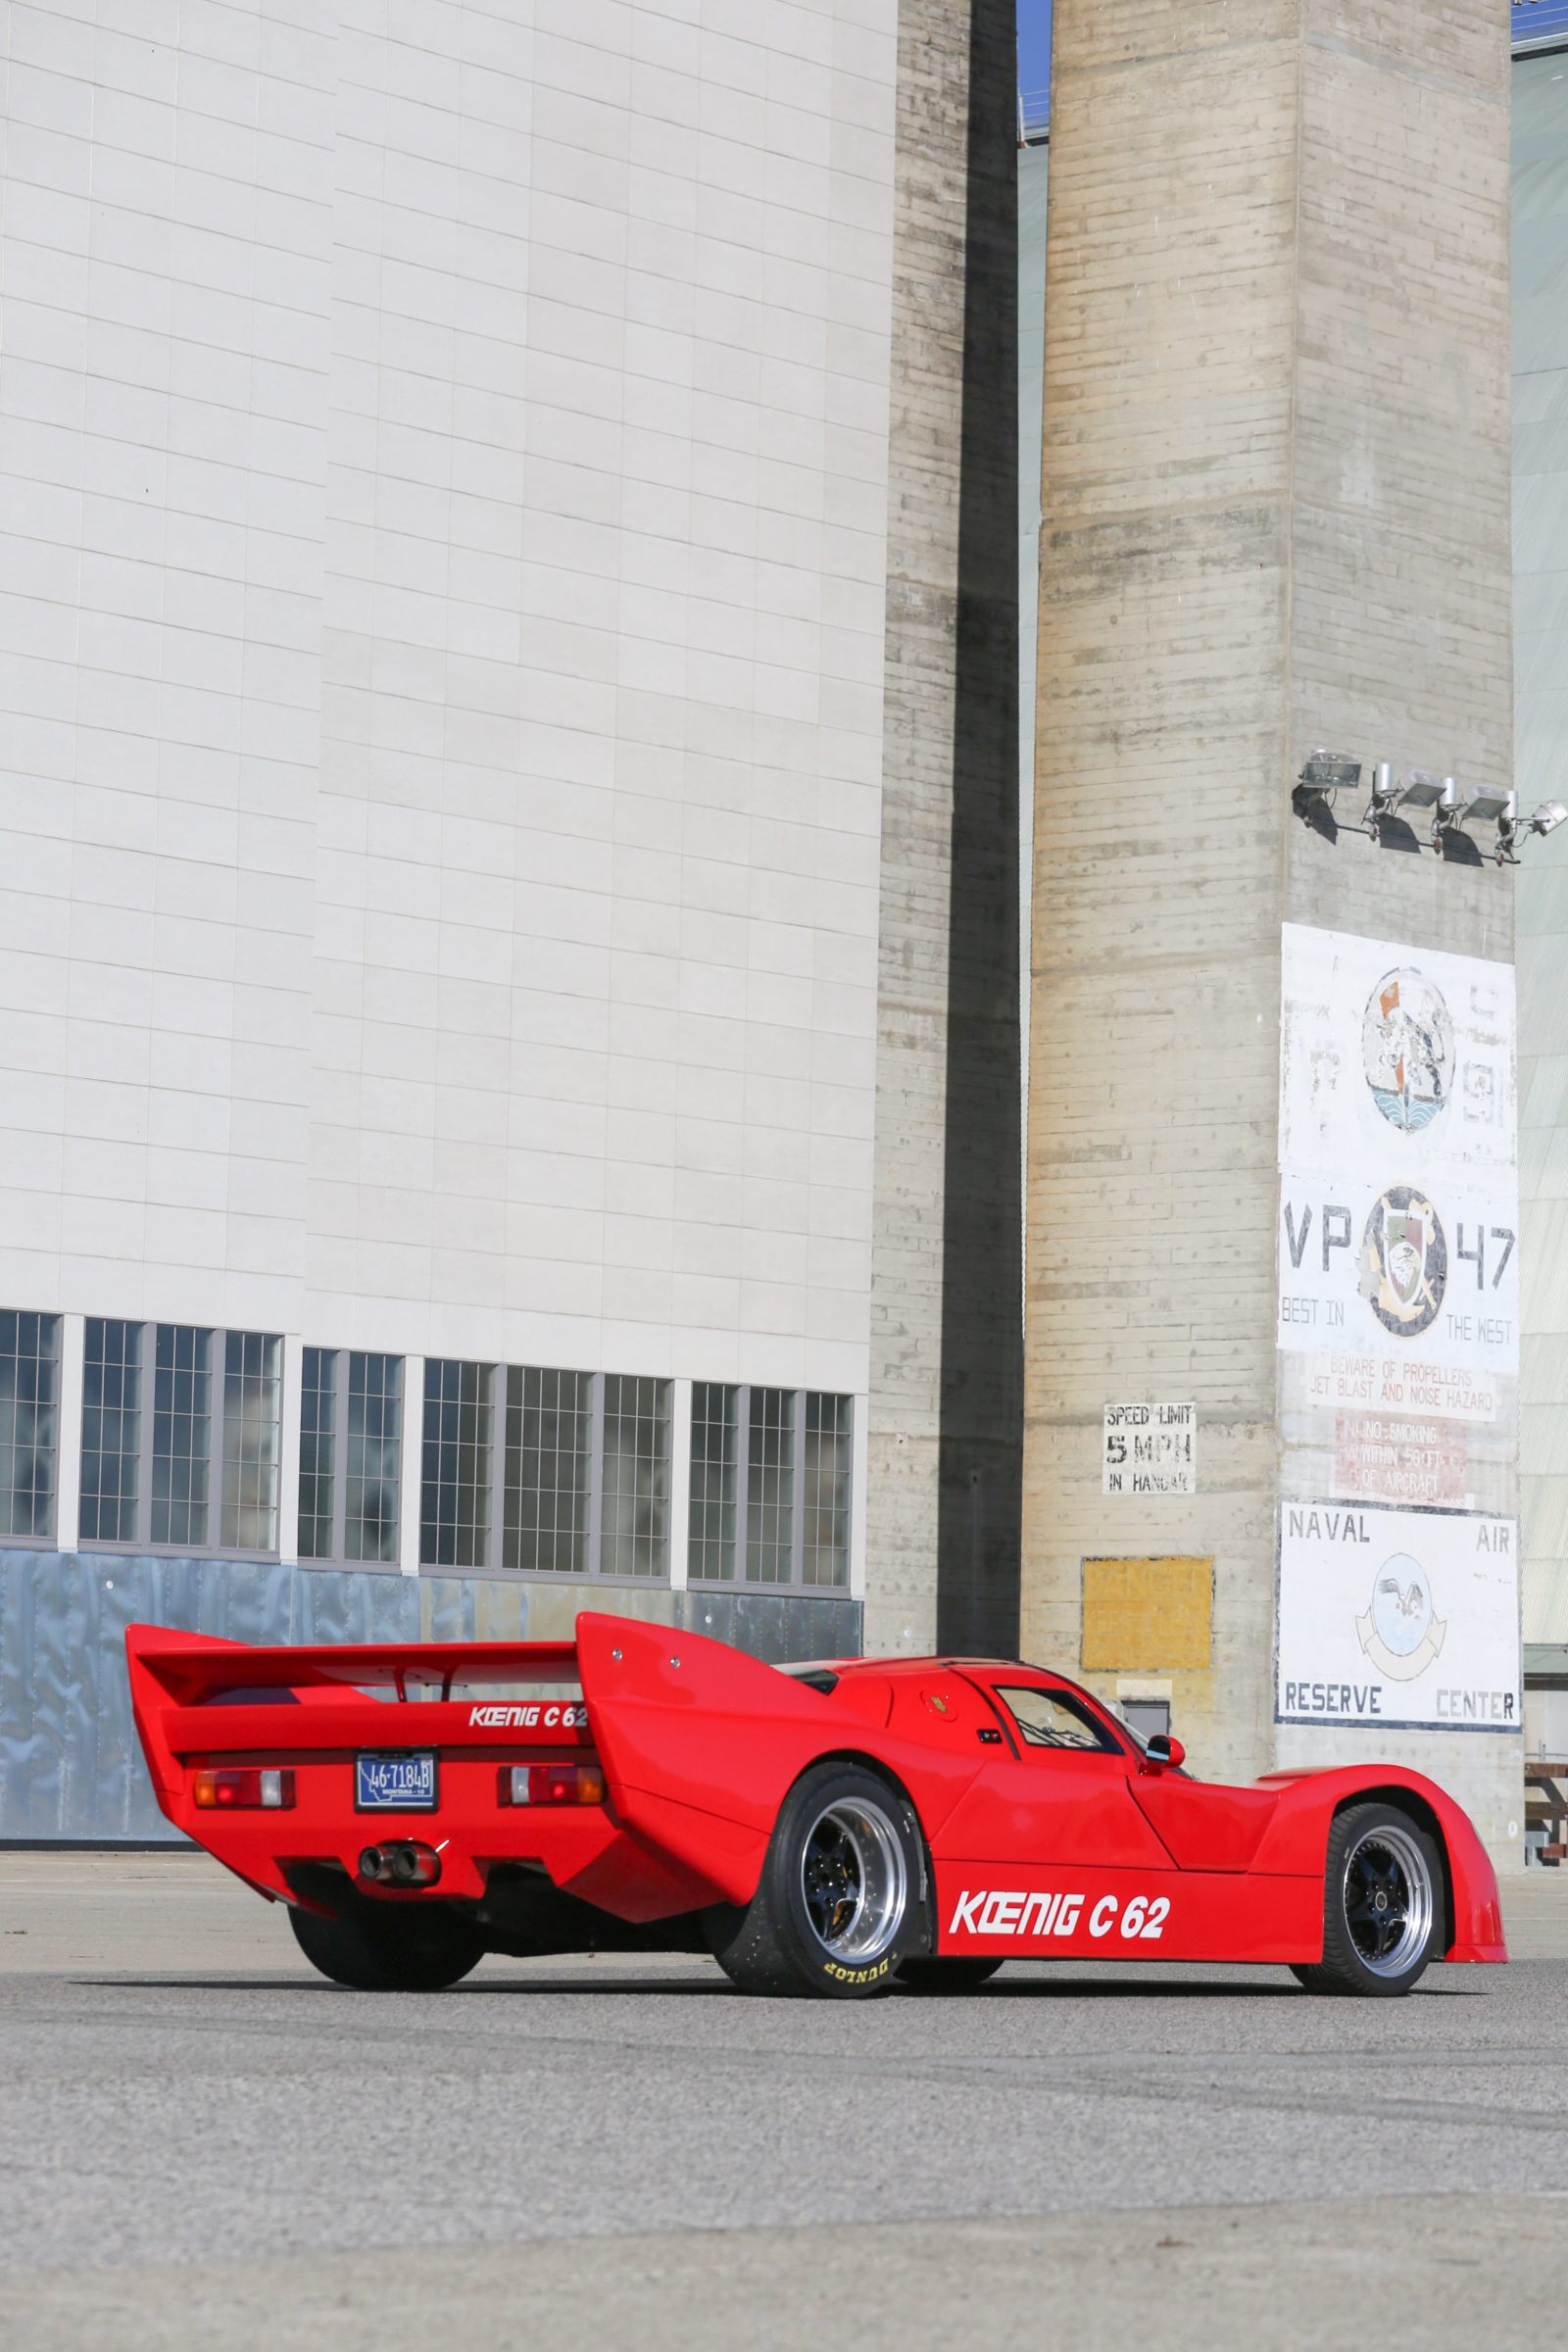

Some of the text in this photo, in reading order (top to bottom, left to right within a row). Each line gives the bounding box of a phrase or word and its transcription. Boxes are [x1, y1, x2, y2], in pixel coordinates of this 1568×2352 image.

[1284, 1200, 1516, 1291] VP 47
[1282, 1297, 1512, 1345] BEST IN THE WEST
[1331, 1355, 1472, 1387] BEWARE OF PROPELLERS
[1310, 1375, 1493, 1411] JET BLAST AND NOISE HAZARD
[1107, 1405, 1192, 1425] SPEED LIMIT
[1365, 1420, 1437, 1445] NO SMOKING
[1106, 1435, 1192, 1463] 5 MPH
[1362, 1444, 1397, 1467] WITHIN
[1109, 1473, 1122, 1491] IN
[1362, 1469, 1438, 1493] OF AIRCRAFT
[1289, 1509, 1510, 1553] NAVAL AIR
[1286, 1682, 1514, 1720] RESERVE CENTER
[544, 1706, 560, 1727] C
[562, 1706, 588, 1727] 62
[1089, 1894, 1119, 1938] C
[1120, 1895, 1171, 1938] 62
[824, 1957, 889, 1984] DUNLOP
